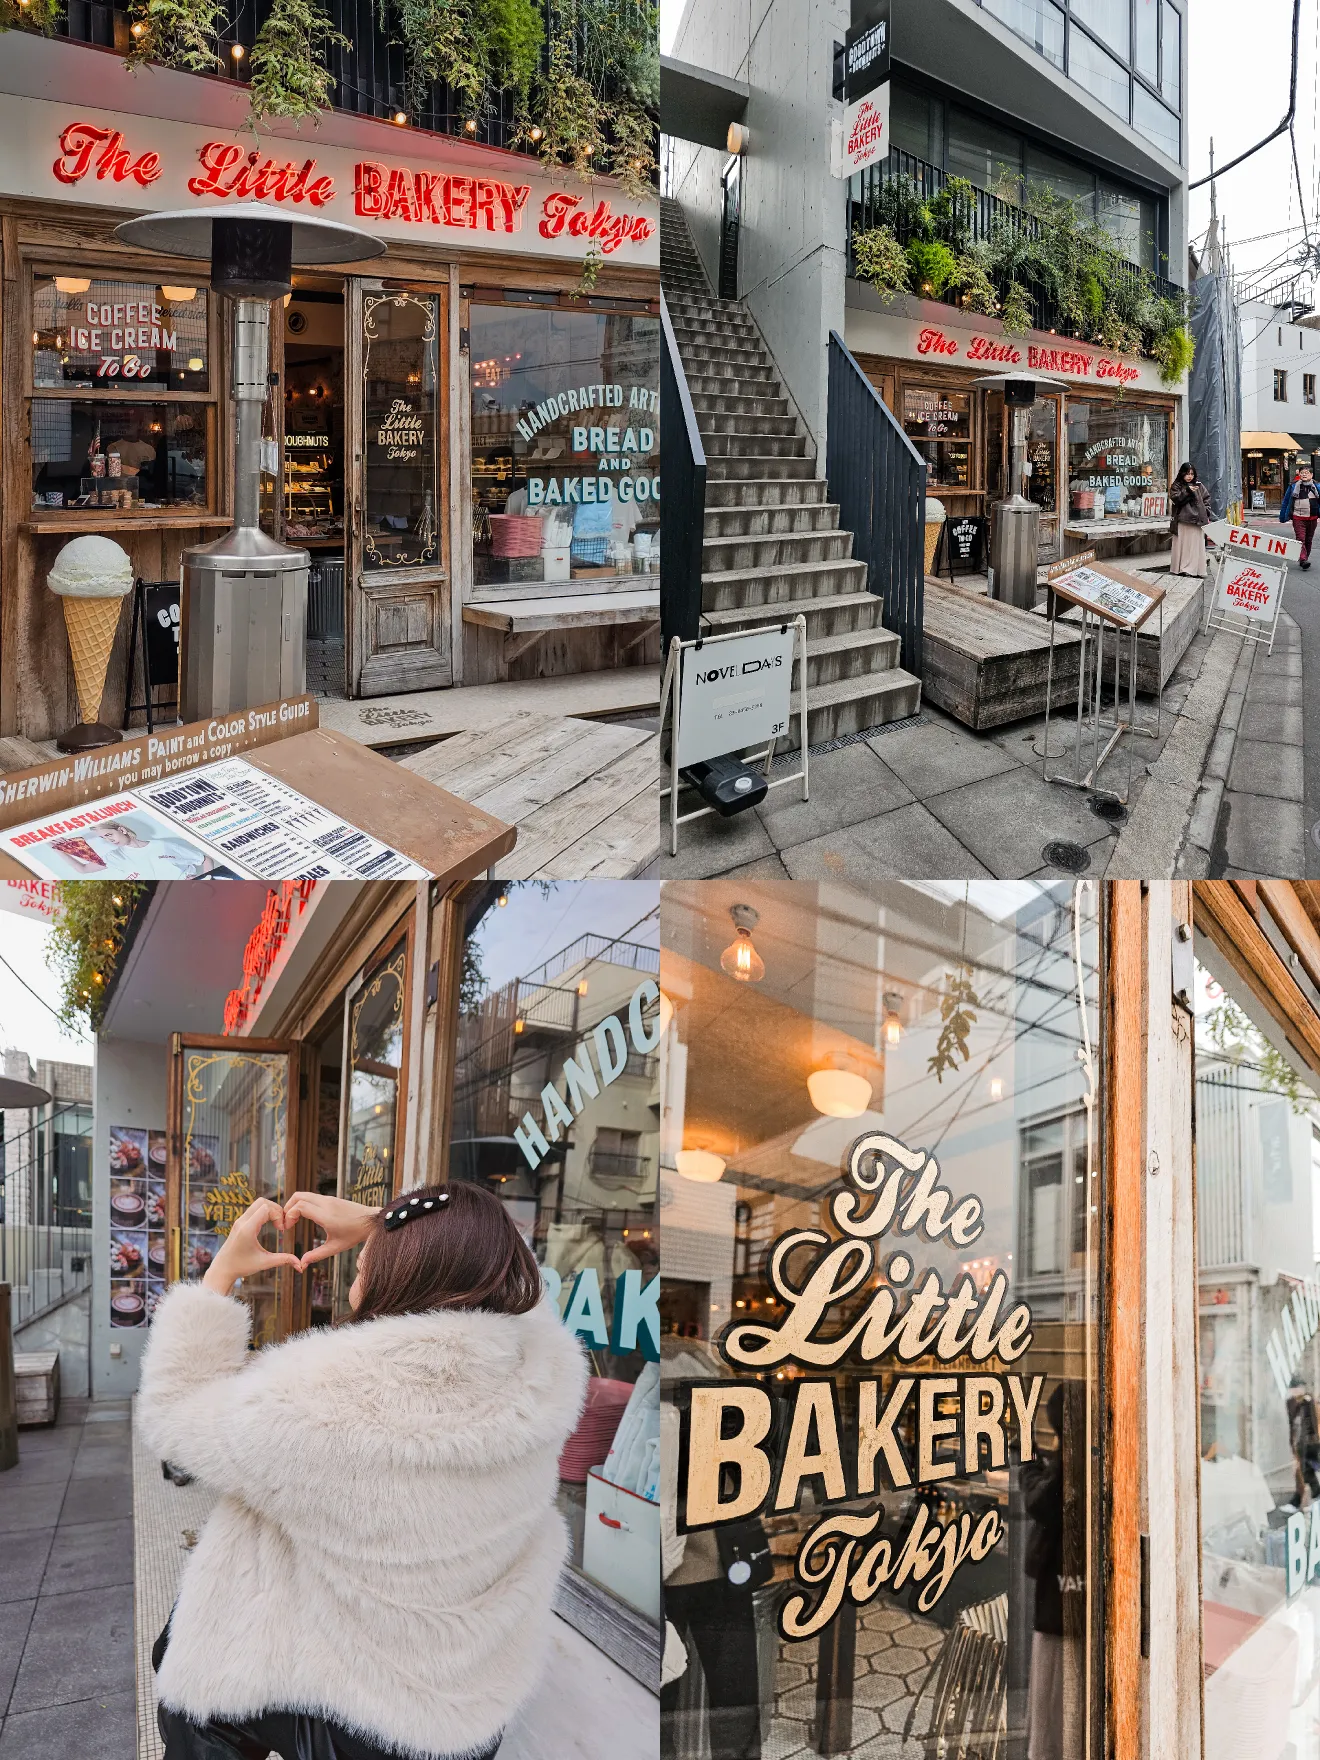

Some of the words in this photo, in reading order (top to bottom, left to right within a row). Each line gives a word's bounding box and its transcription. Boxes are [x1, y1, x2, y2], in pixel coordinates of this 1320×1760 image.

[858, 101, 874, 119] The
[850, 110, 881, 138] Little
[848, 123, 883, 155] BAKERY
[854, 146, 876, 165] Tokyo
[52, 122, 163, 187] The
[187, 141, 338, 207] Little
[353, 161, 533, 234] BAKERY
[539, 191, 657, 254] Tokyo
[86, 302, 162, 326] COFFEE
[69, 326, 102, 351] ICE
[109, 327, 177, 351] CREAM
[97, 356, 121, 378] To
[121, 356, 151, 379] Go
[917, 329, 959, 355] The
[967, 336, 1022, 364] Little
[1027, 345, 1095, 376] BAKERY
[1096, 358, 1142, 384] Tokyo
[391, 399, 412, 414] The
[515, 384, 623, 443] HANDCRAFTED
[924, 401, 953, 411] COFFEE
[932, 411, 958, 422] CREAM
[380, 413, 422, 430] Little
[377, 430, 425, 446] BAKERY
[572, 426, 655, 454] BREAD
[1084, 436, 1126, 461] HANDCRAFTED
[386, 446, 417, 461] Tokyo
[598, 458, 631, 471] AND
[1106, 454, 1137, 466] BREAD
[527, 476, 614, 506] BAKED
[1089, 475, 1121, 487] BAKED
[1123, 475, 1153, 487] GOODS
[1143, 496, 1165, 517] OPEN
[952, 525, 978, 537] COFFEE
[1229, 529, 1261, 549] EAT
[1267, 539, 1288, 556] IN
[1230, 574, 1269, 593] Little
[1241, 567, 1262, 579] The
[1226, 583, 1270, 605] BAKERY
[1232, 597, 1260, 611] Tokyo
[771, 721, 785, 734] 3F
[0, 748, 142, 804] SHERWIN-WILLIAMS
[148, 736, 185, 760] PAINT
[187, 730, 205, 748] and
[208, 719, 246, 742] COLOR
[248, 710, 277, 731] STYLE
[280, 701, 310, 721] GUIDE
[118, 772, 138, 791] you
[141, 764, 162, 779] may
[165, 751, 200, 773] borrow
[202, 751, 208, 760] a
[210, 743, 232, 758] copy
[149, 777, 219, 809] GOODTOWN
[174, 791, 225, 814] DOUGHNUTS
[9, 800, 138, 848] BREAKFAST&LUNCH
[220, 822, 280, 851] SANDWICHES
[353, 1161, 384, 1191] Little
[832, 1132, 985, 1249] The
[721, 1228, 1035, 1370] Little
[681, 1373, 1046, 1532] BAKERY
[779, 1502, 1005, 1641] Tokyo
